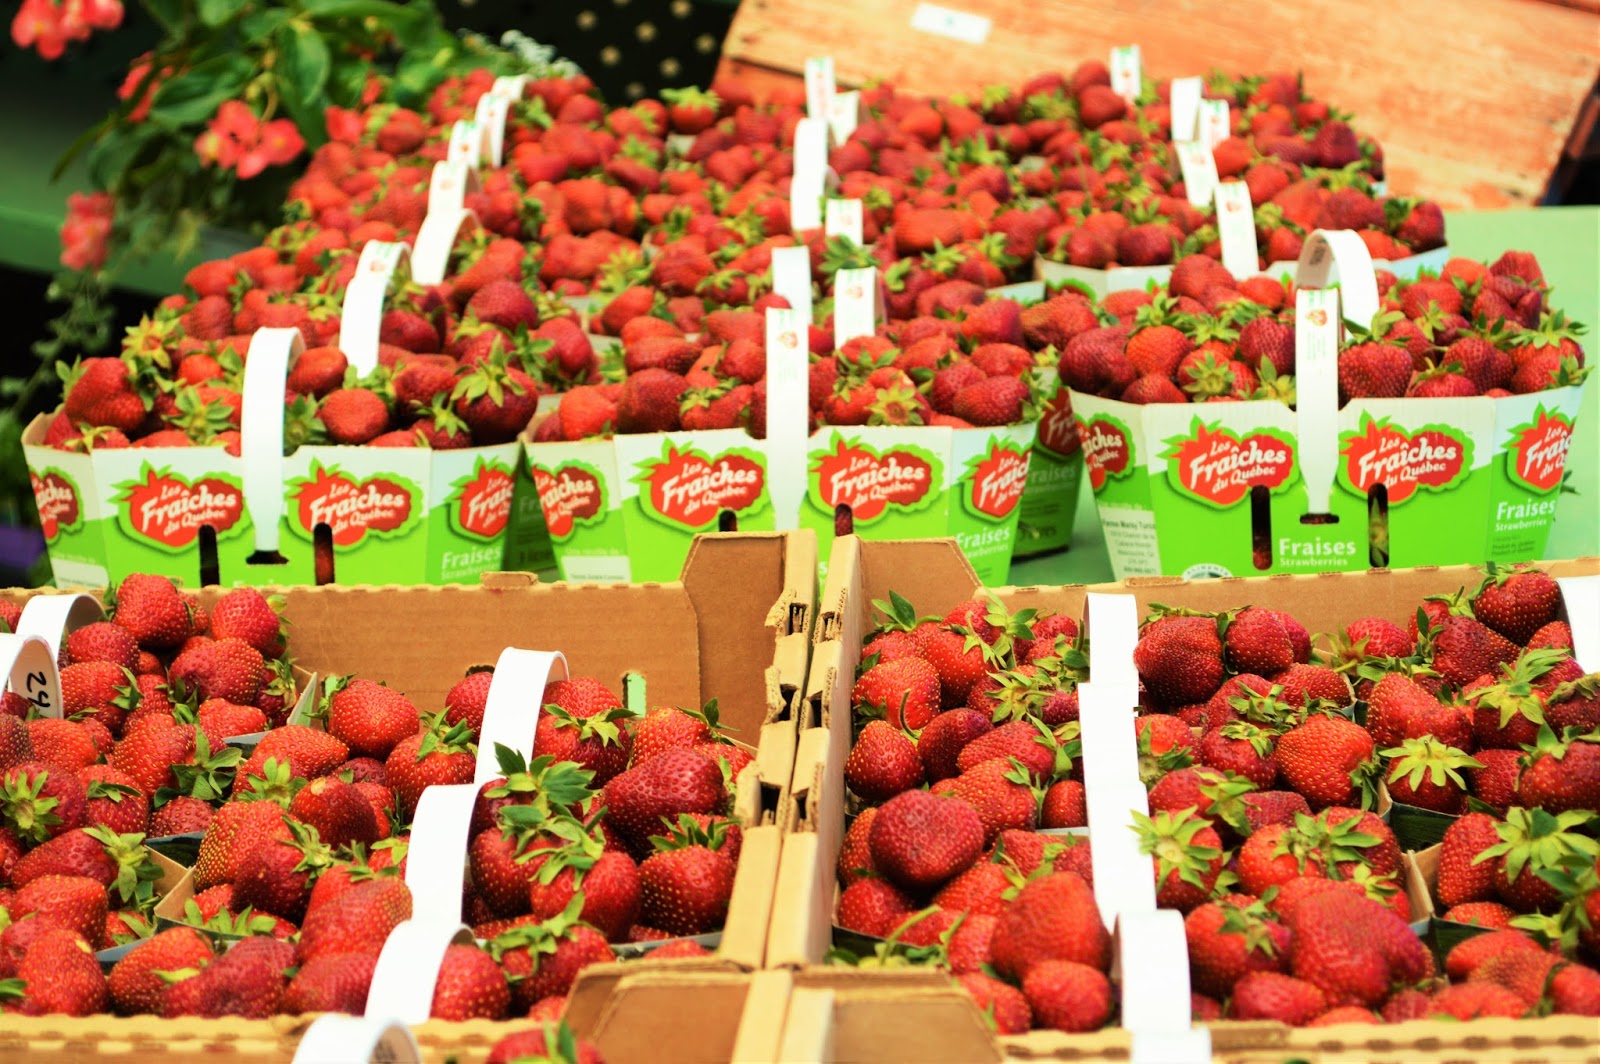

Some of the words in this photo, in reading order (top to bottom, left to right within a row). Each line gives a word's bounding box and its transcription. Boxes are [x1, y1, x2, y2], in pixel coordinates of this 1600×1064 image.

[1379, 437, 1400, 453] Les
[1544, 426, 1562, 443] Les
[1210, 441, 1231, 456] Les
[1523, 431, 1571, 478] Fraîc
[681, 462, 702, 478] Les
[849, 457, 870, 472] Les
[998, 456, 1015, 472] Les
[1189, 441, 1287, 490] Fraîches
[1358, 437, 1457, 488] Fraîches
[1540, 463, 1554, 480] du
[486, 476, 503, 493] Les
[830, 457, 926, 504] Fraîches
[1212, 478, 1229, 495] du
[1230, 465, 1276, 485] Québec
[1383, 474, 1400, 489] du
[1400, 462, 1447, 481] Québec
[161, 485, 182, 499] Les
[329, 483, 350, 498] Les
[660, 462, 758, 513] Fraîches
[851, 492, 868, 508] du
[869, 476, 917, 500] Québec
[141, 485, 238, 533] Fraîches
[309, 484, 406, 529] Fraîches
[683, 499, 701, 516] du
[701, 485, 748, 505] Québec
[994, 492, 1008, 508] du
[1496, 498, 1556, 520] Fraises
[163, 521, 181, 537] du
[180, 509, 229, 528] Québec
[332, 520, 348, 536] du
[349, 507, 396, 526] Québec
[1495, 518, 1547, 531] Strawberries
[1279, 536, 1357, 556] Fraises
[442, 546, 500, 569] Fraises
[1279, 557, 1349, 567] Strawberries
[26, 671, 51, 708] 24
